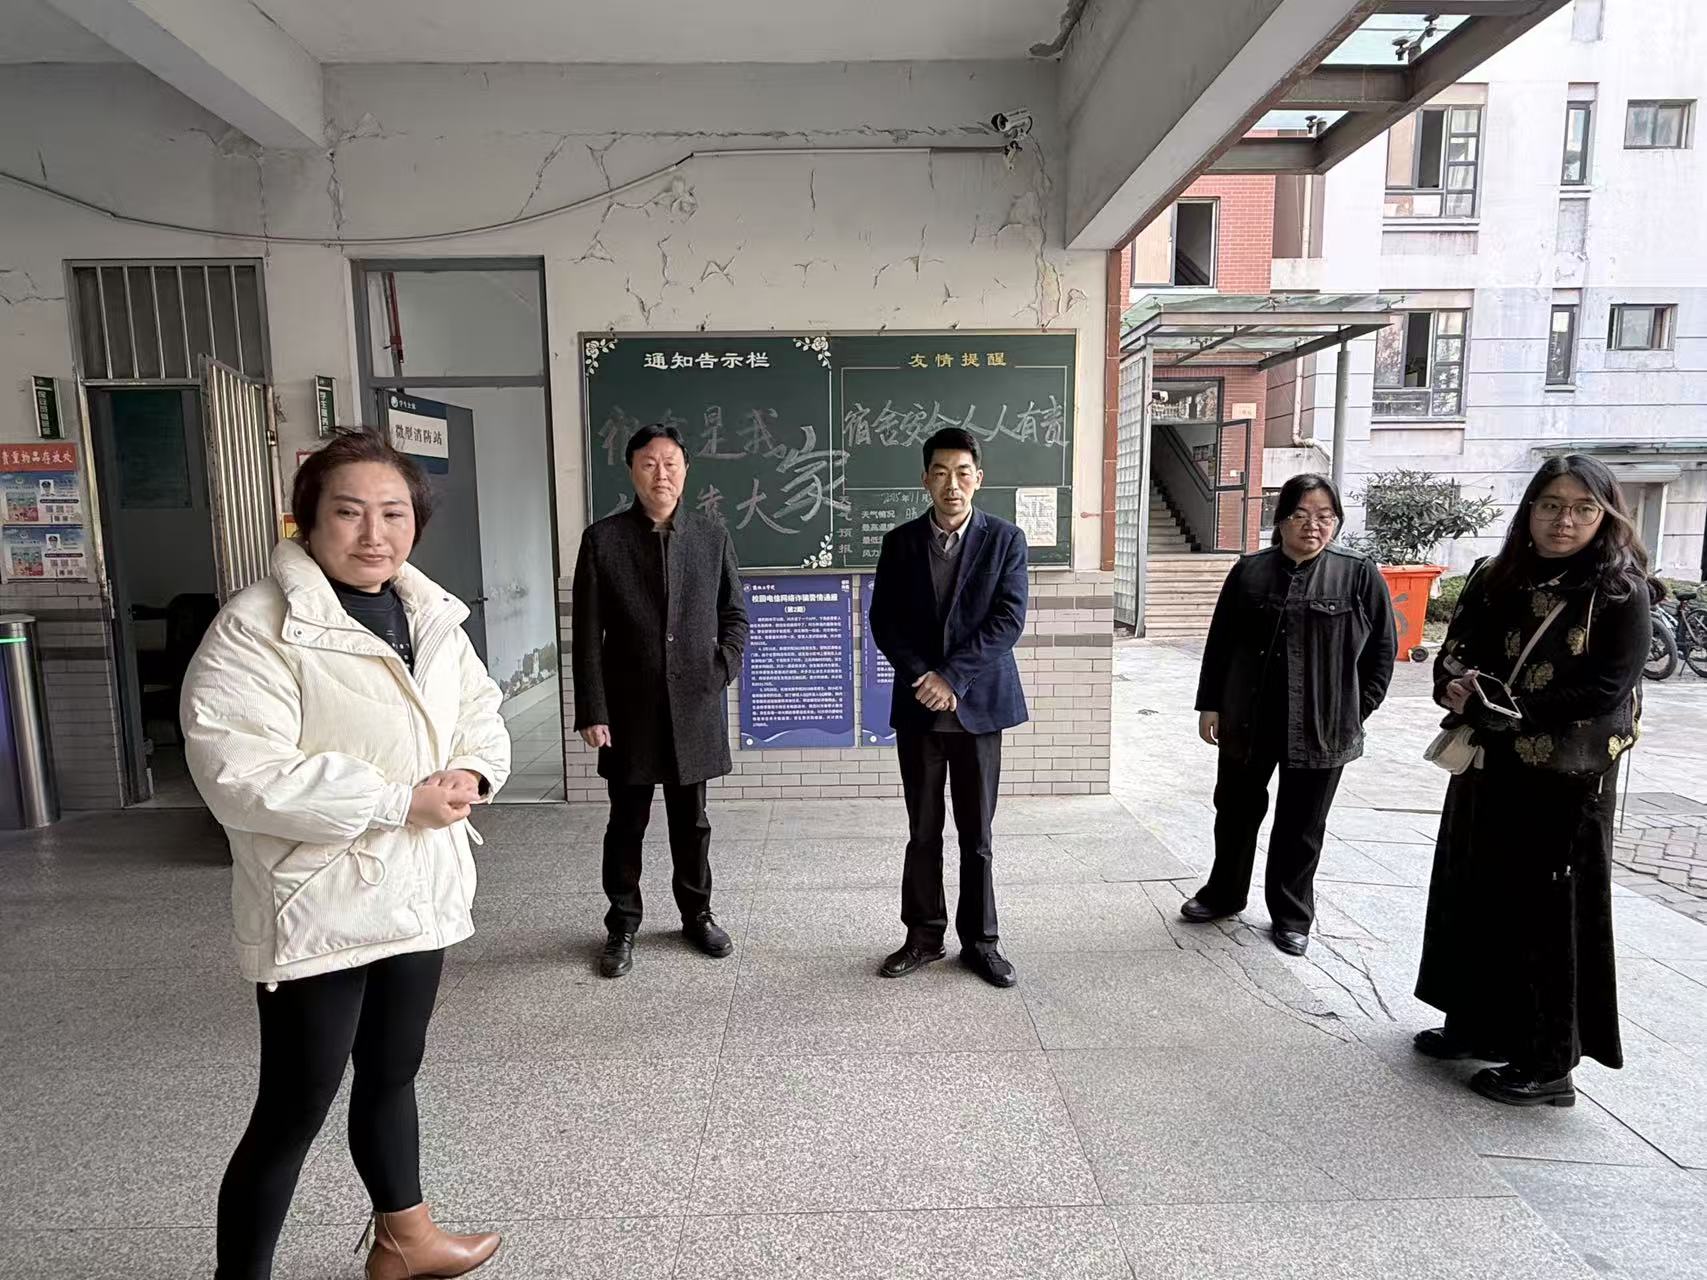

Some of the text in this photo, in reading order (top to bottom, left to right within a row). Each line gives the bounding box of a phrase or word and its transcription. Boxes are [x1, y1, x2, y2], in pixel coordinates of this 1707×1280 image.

[643, 352, 770, 370] 通知告示栏
[908, 352, 1007, 368] 友情提醒
[395, 424, 442, 446] 微型消防站
[2, 448, 73, 465] 贵重物品存放处
[861, 510, 896, 519] 天气情况
